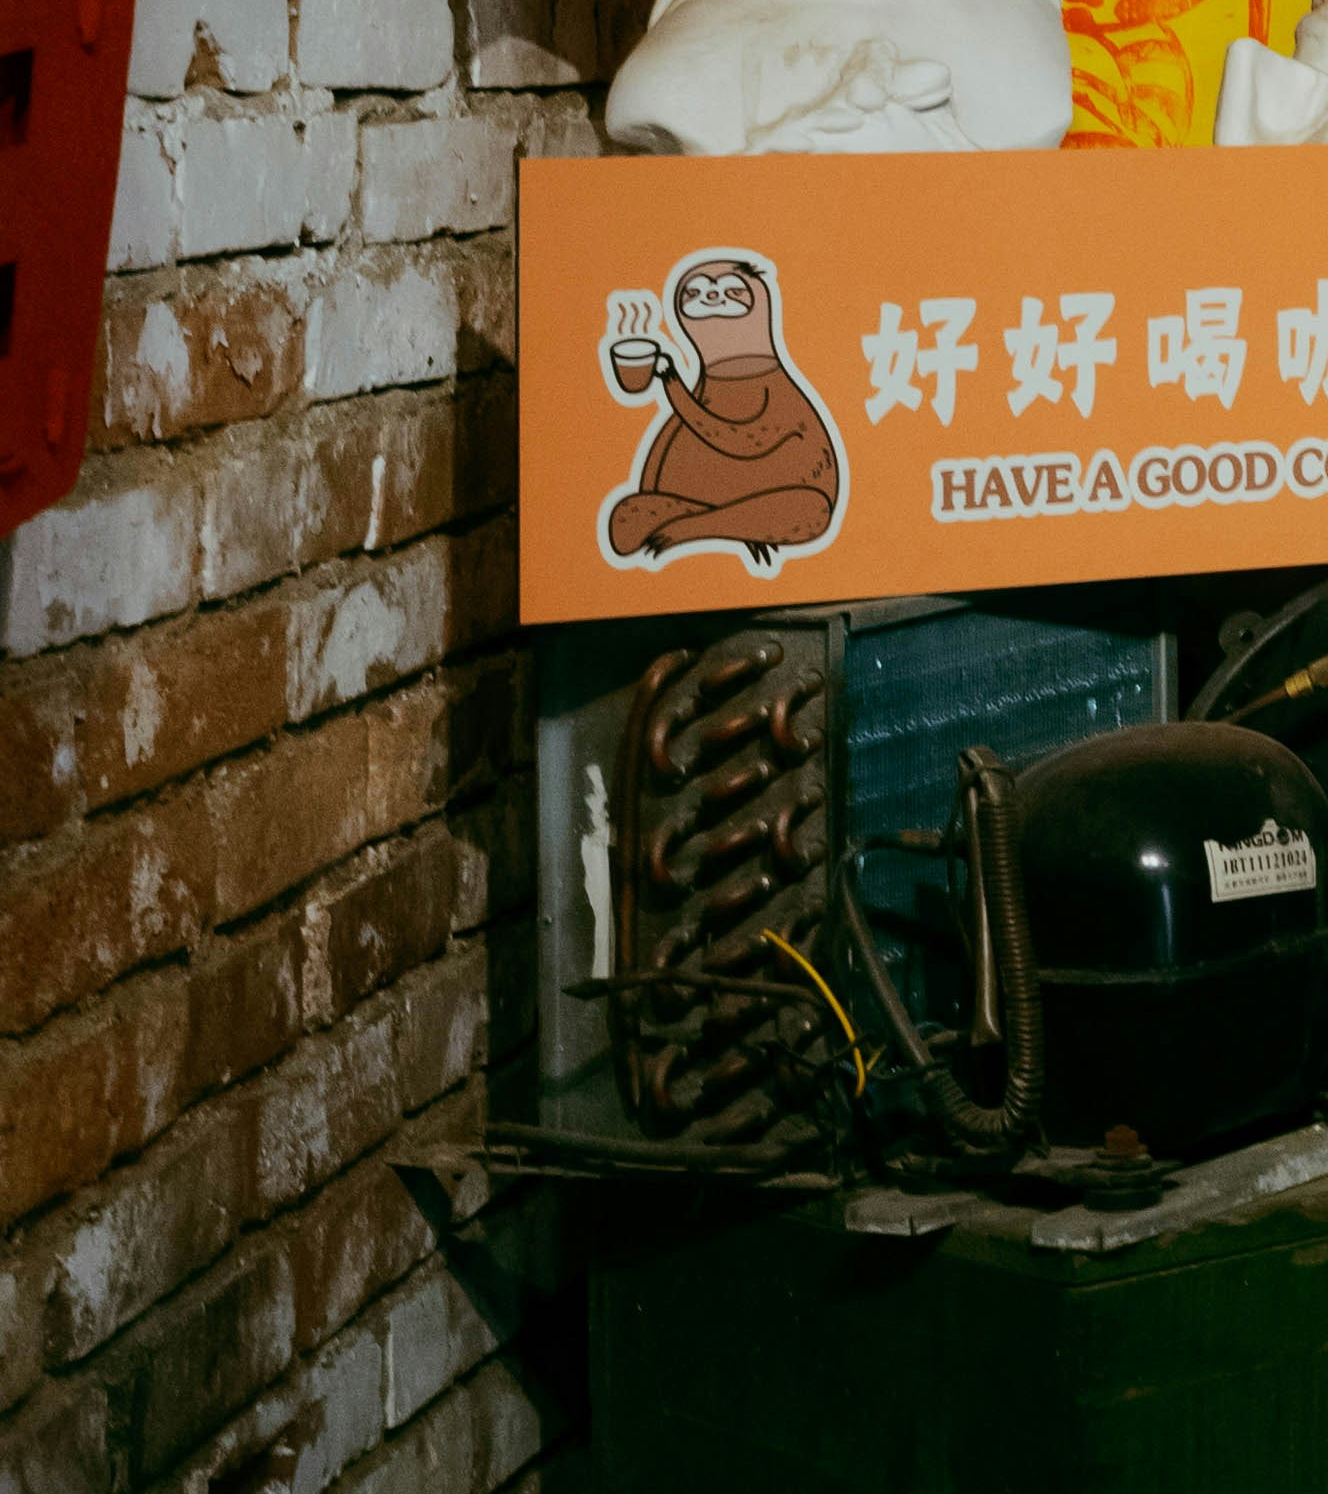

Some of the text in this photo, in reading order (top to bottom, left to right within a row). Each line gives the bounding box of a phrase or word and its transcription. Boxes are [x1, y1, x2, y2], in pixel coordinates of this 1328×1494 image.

[935, 462, 1082, 514] HAVE
[1088, 460, 1125, 504] A
[1137, 452, 1279, 500] GOOD
